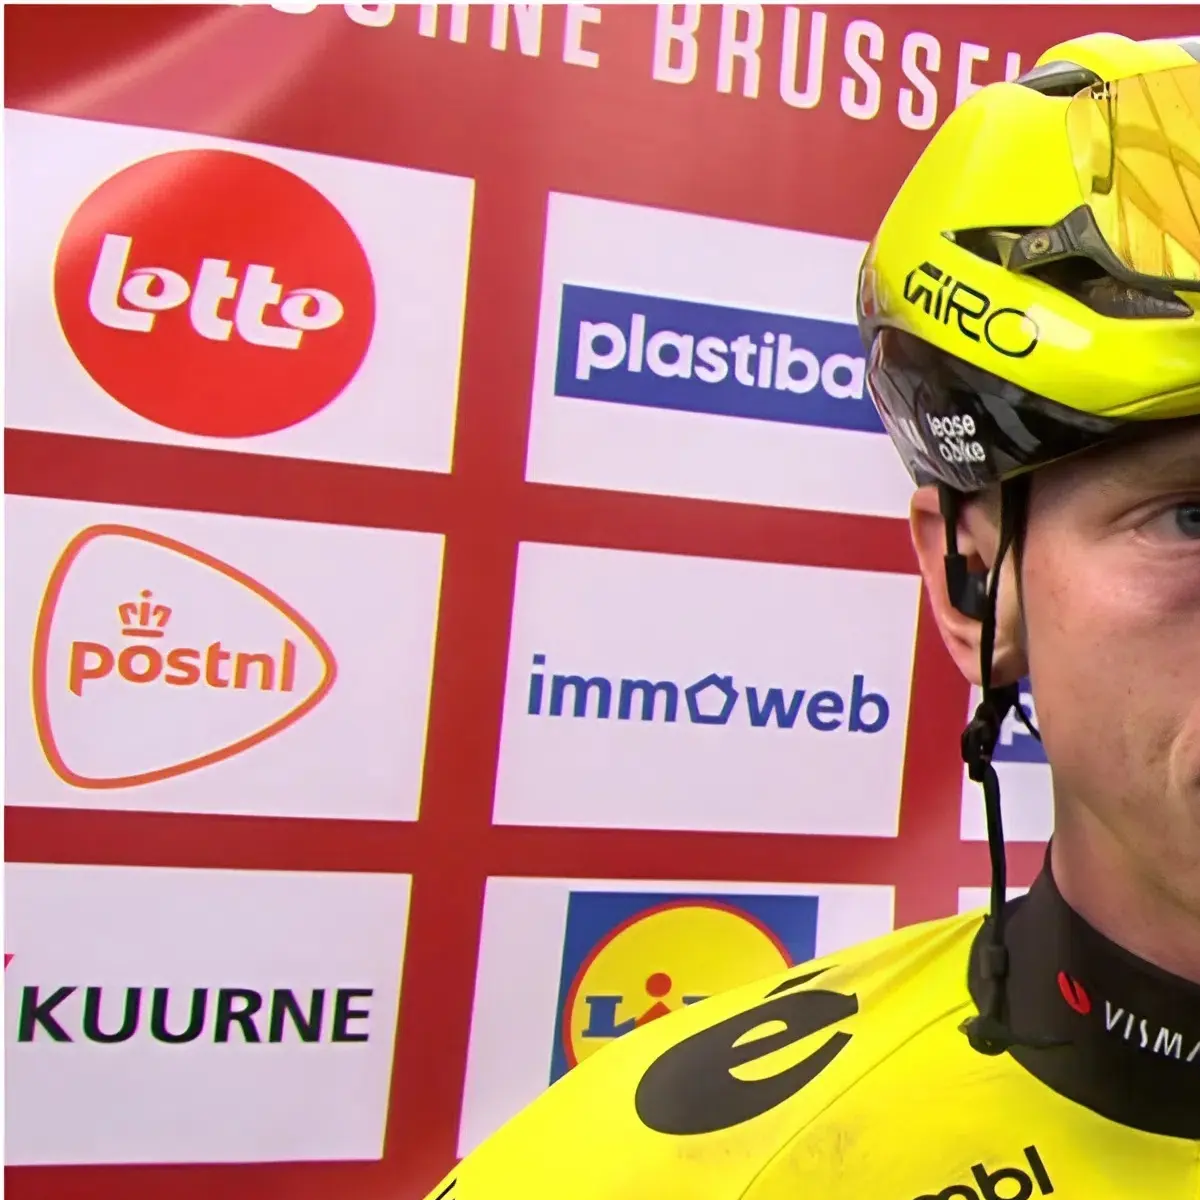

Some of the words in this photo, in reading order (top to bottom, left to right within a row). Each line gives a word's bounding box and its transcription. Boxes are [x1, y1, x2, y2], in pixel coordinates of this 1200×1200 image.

[904, 261, 1040, 359] GIRO
[575, 314, 866, 400] plastiba
[925, 412, 977, 437] lease
[68, 637, 297, 698] postnl
[17, 984, 375, 1044] KUURNE
